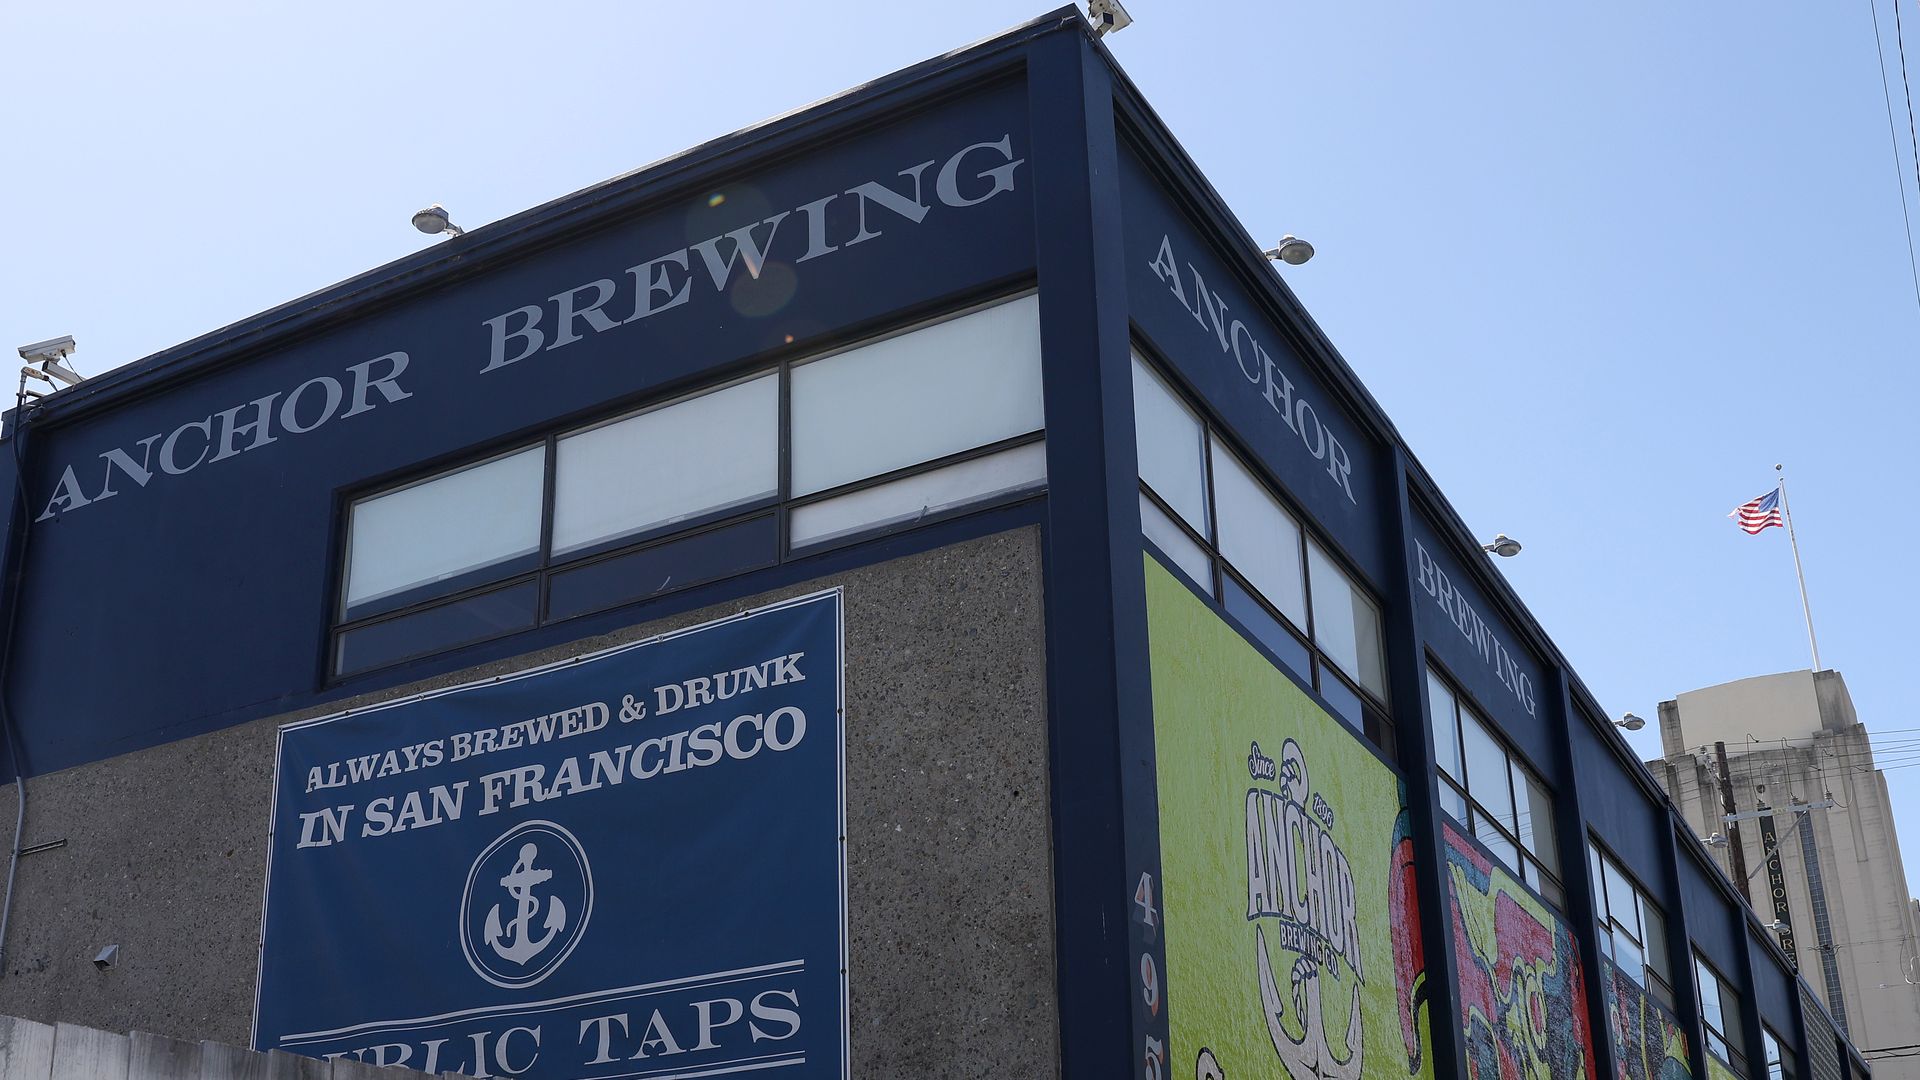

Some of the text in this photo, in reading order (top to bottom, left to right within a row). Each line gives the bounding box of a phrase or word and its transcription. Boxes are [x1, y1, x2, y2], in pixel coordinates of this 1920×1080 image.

[35, 133, 1024, 522] ANCHOR BREWING
[1149, 235, 1536, 719] ANCHOR BREWING
[297, 706, 807, 849] IN SAN FRANCISCO
[305, 652, 806, 793] ALWAYS BREWED & DRUNK
[1248, 742, 1334, 829] Since 1896
[1246, 788, 1365, 987] ANCHOR
[1280, 921, 1323, 966] BREWING
[578, 989, 801, 1065] TAPS
